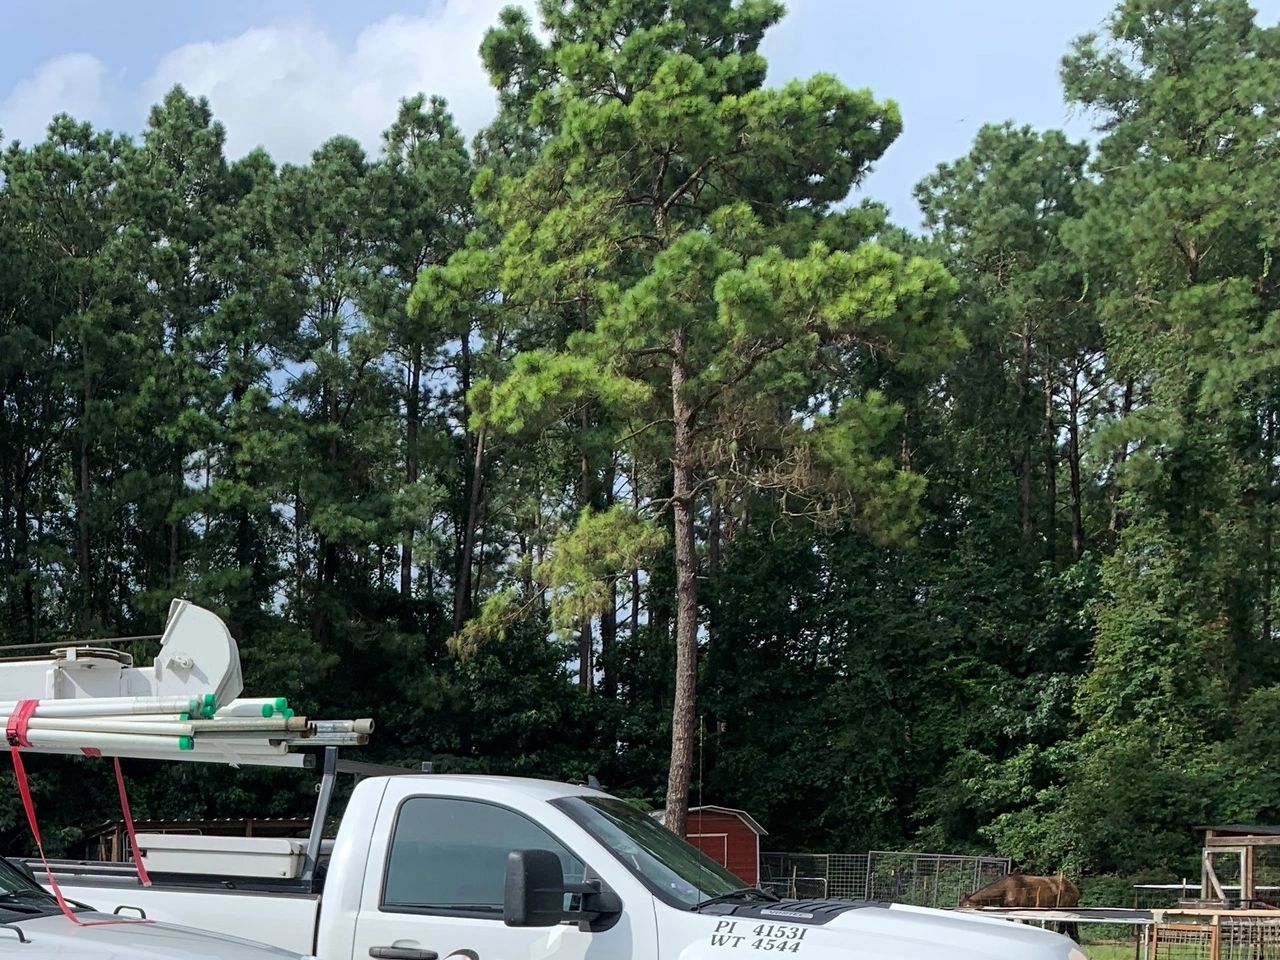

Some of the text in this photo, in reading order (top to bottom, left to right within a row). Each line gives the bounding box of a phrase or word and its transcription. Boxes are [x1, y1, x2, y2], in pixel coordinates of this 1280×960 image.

[714, 920, 738, 934] PI
[710, 934, 801, 953] WT 4544
